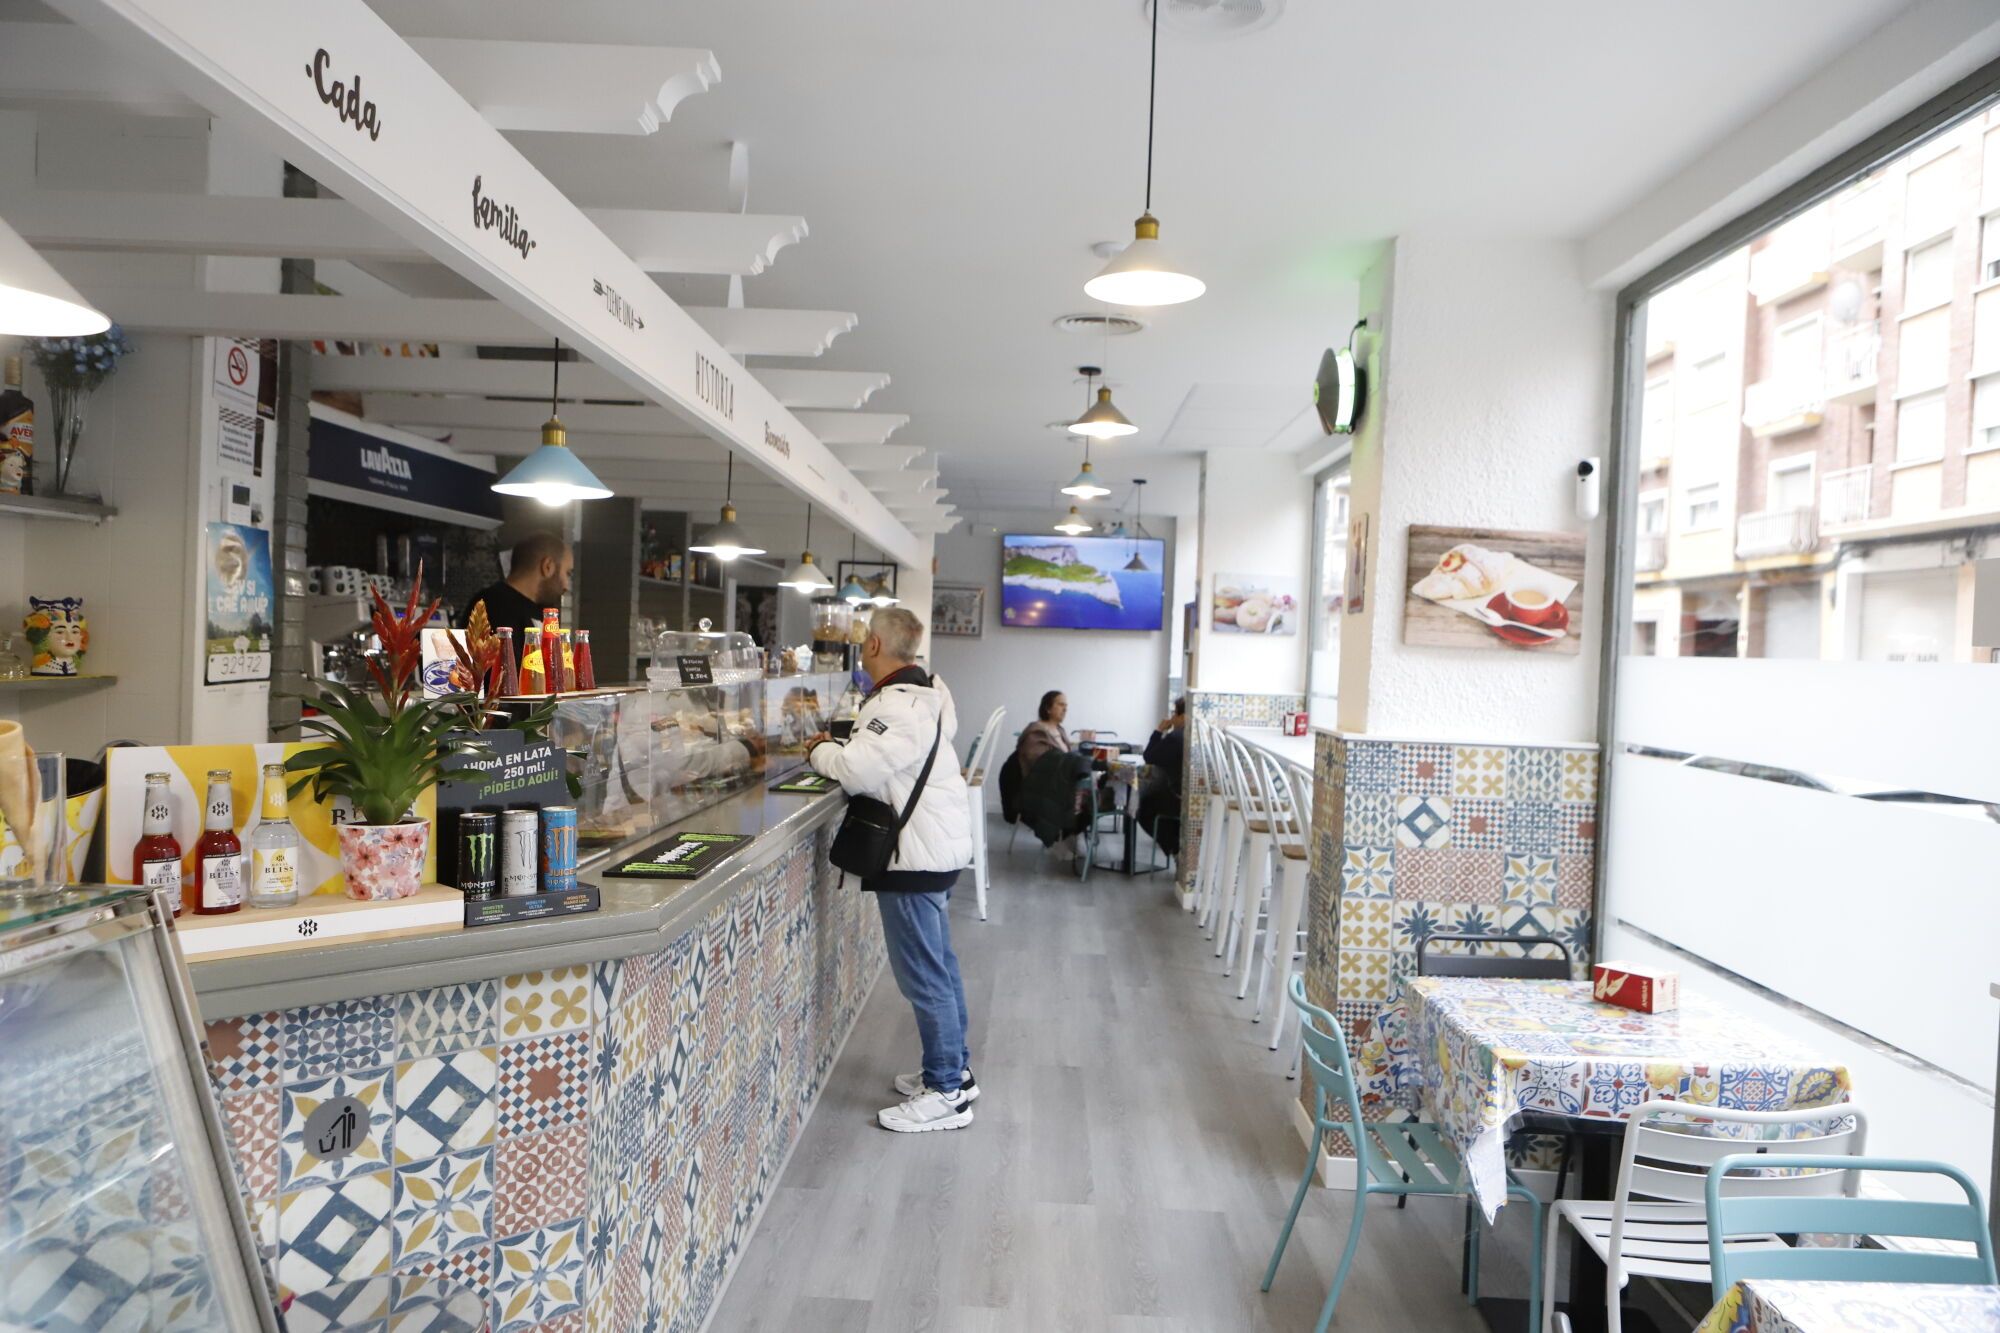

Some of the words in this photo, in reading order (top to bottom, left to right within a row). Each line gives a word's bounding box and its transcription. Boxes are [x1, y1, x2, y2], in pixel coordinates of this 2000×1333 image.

[313, 48, 381, 141] Cada
[472, 175, 531, 260] familia
[605, 285, 622, 323] TIENE
[622, 300, 635, 332] UNA
[695, 352, 734, 422] HISTORIA
[361, 446, 413, 480] LAVAZZA
[221, 655, 263, 675] 32972
[503, 767, 524, 780] 250
[527, 761, 545, 774] ml!
[505, 752, 521, 766] EN
[524, 746, 552, 763] LATA
[479, 779, 526, 800] ¡PÍDELO
[528, 767, 559, 787] AQUÍ!
[264, 866, 294, 874] BLISS
